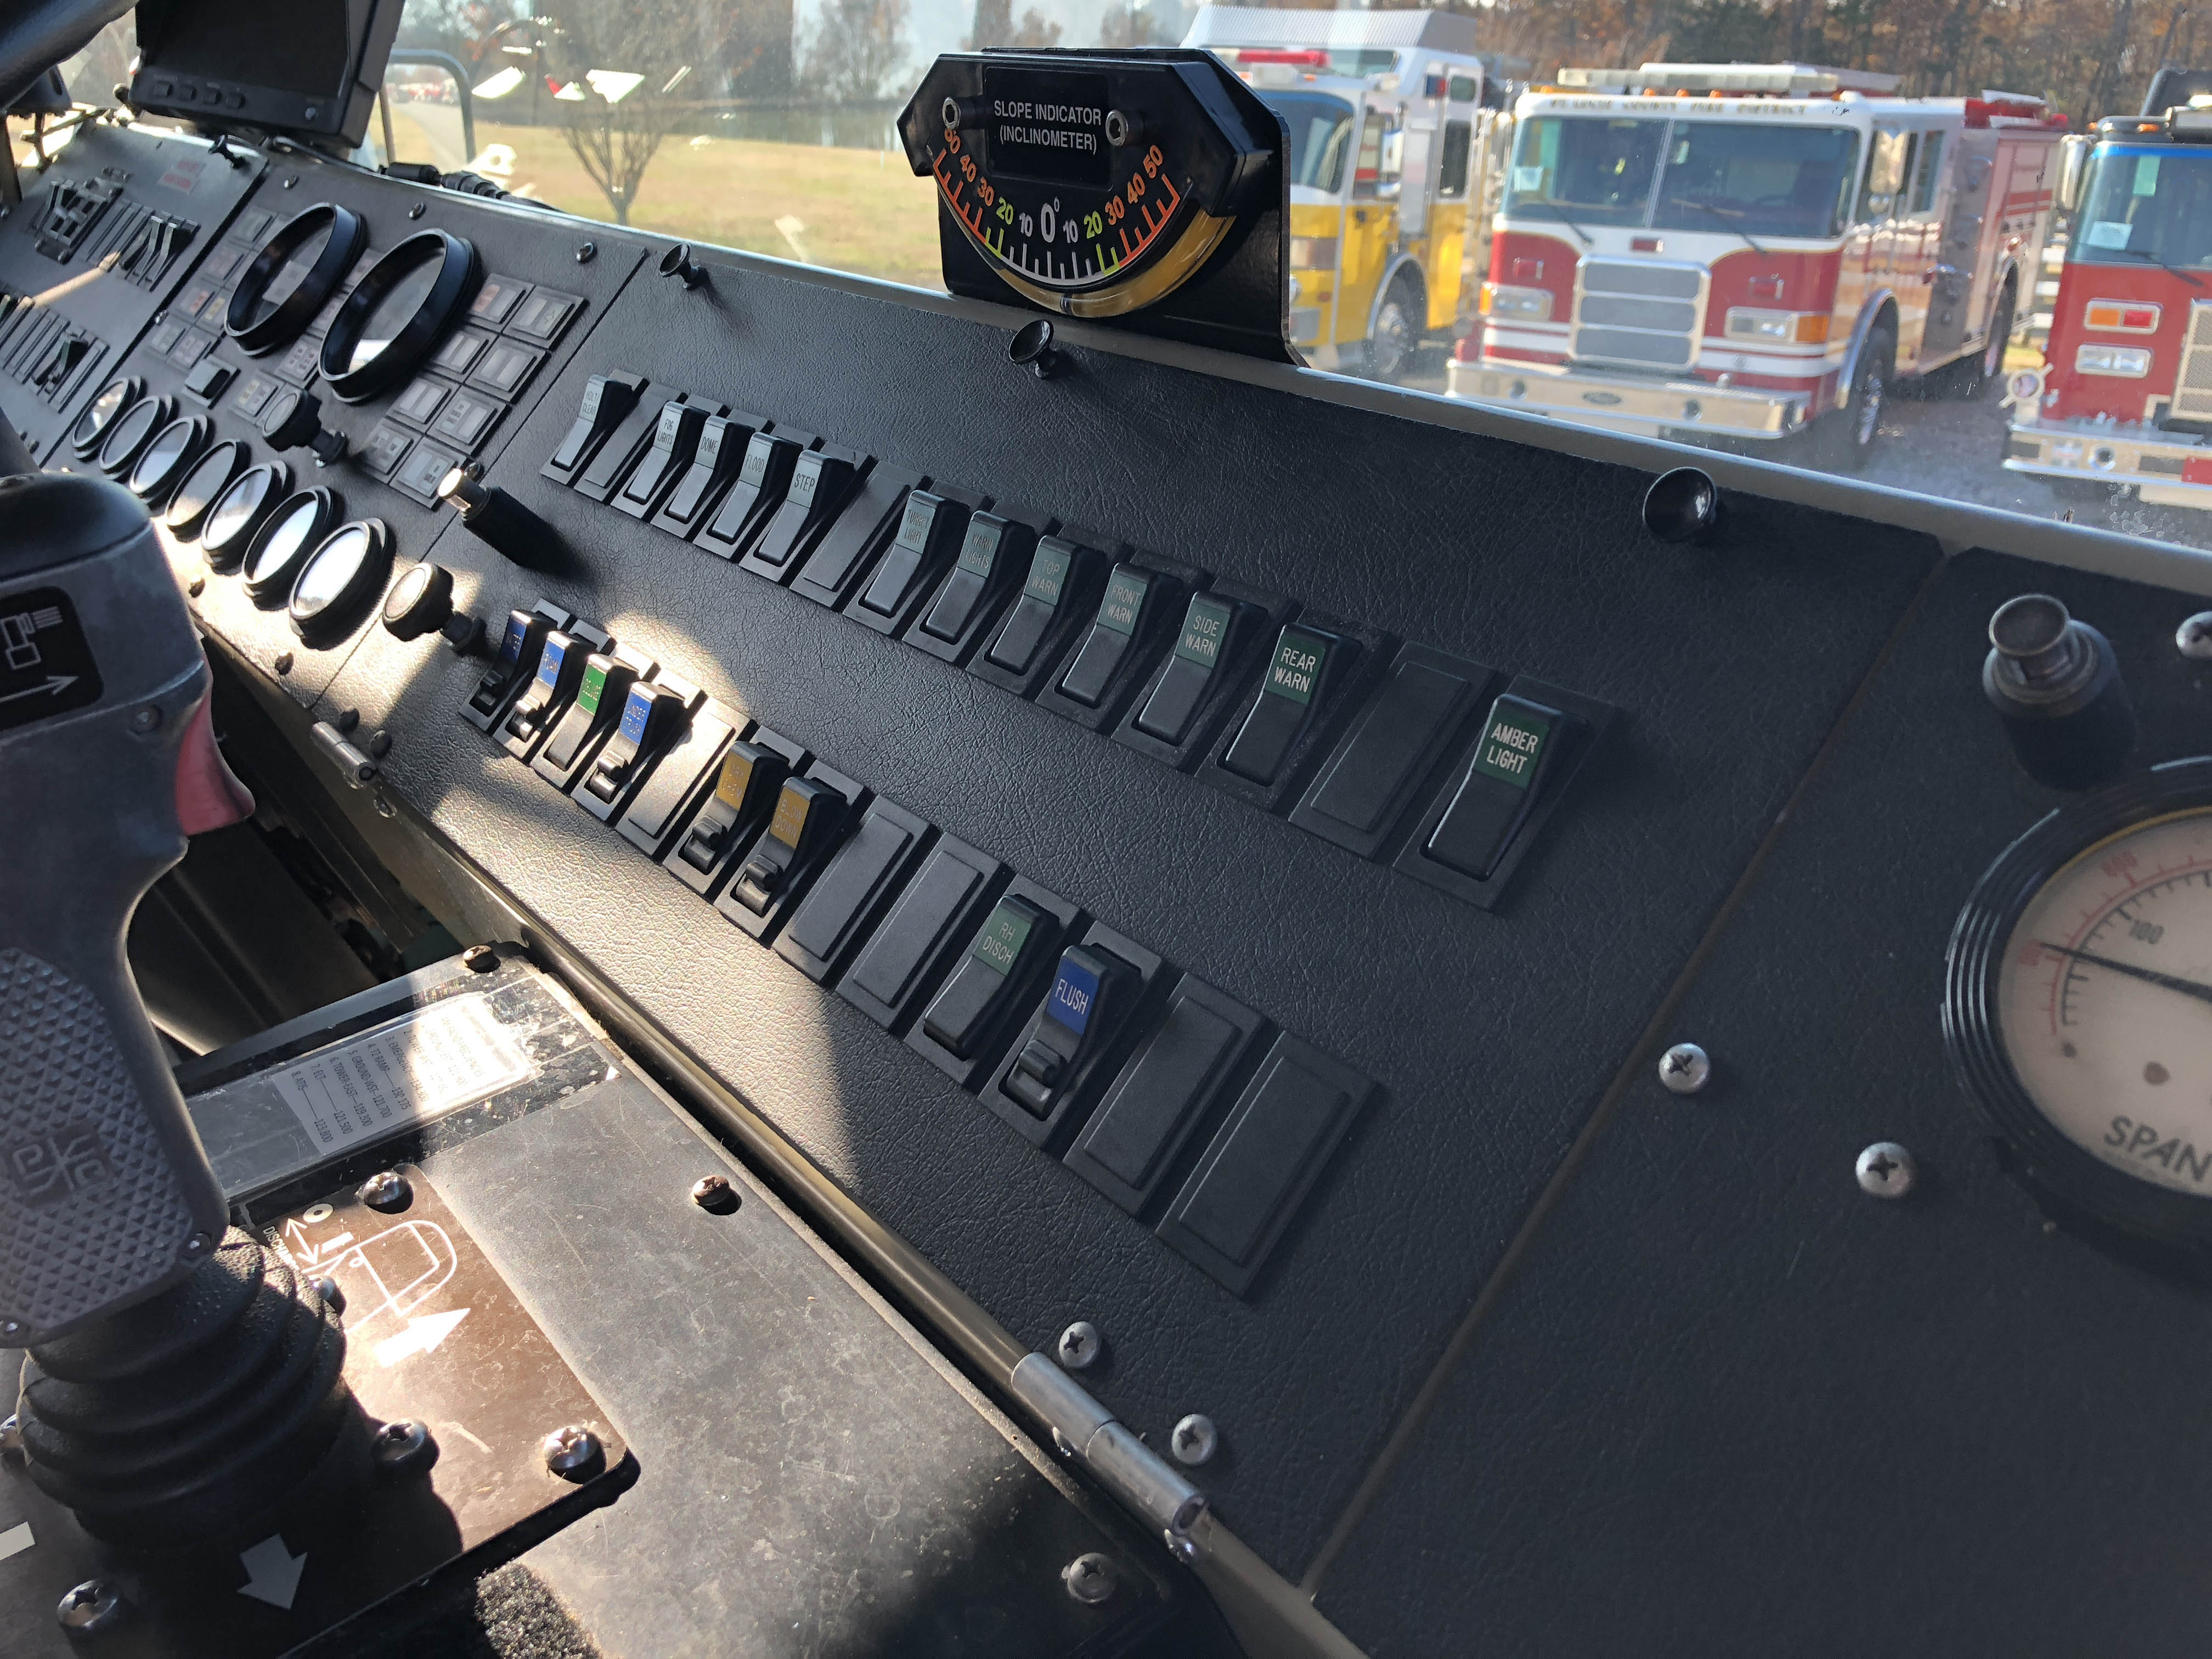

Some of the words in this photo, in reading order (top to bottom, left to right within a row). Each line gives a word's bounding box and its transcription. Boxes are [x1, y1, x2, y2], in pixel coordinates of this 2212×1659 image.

[994, 100, 1032, 119] SLOPE
[1035, 104, 1102, 126] INDICATOR
[1000, 125, 1097, 155] (INCLINOMETER)
[960, 155, 977, 183] 40
[977, 177, 994, 207] 30
[996, 196, 1014, 225] 20
[1019, 212, 1033, 237] 10
[1063, 219, 1079, 243] 10
[1084, 210, 1103, 239] 20
[1105, 195, 1125, 225] 30
[1127, 172, 1146, 205] 40
[1143, 145, 1163, 178] 50
[664, 418, 674, 431] FOG
[658, 431, 673, 445] LIGHTS
[700, 436, 718, 455] DOME
[745, 454, 765, 473] FLOOD
[794, 473, 815, 492] STEP
[904, 527, 923, 545] LIGHT
[972, 532, 994, 553] WARN
[964, 549, 990, 569] LIGHTS
[1041, 559, 1060, 576] TOP
[1031, 575, 1059, 597] WARN
[1110, 584, 1141, 606] FRONT
[1107, 603, 1133, 624] WARN
[1193, 615, 1220, 636] SIDE
[1185, 633, 1216, 657] WARN
[1280, 647, 1316, 673] REAR
[1274, 666, 1311, 693] WARN
[1491, 723, 1538, 754] AMBER
[1487, 745, 1527, 774] LIGHT
[781, 799, 803, 821] BLOW
[775, 815, 799, 838] DOWN
[999, 922, 1015, 942] RH
[983, 936, 1014, 964] DISCH
[1054, 978, 1089, 1015] FLUSH
[2103, 1115, 2212, 1182] SPAN
